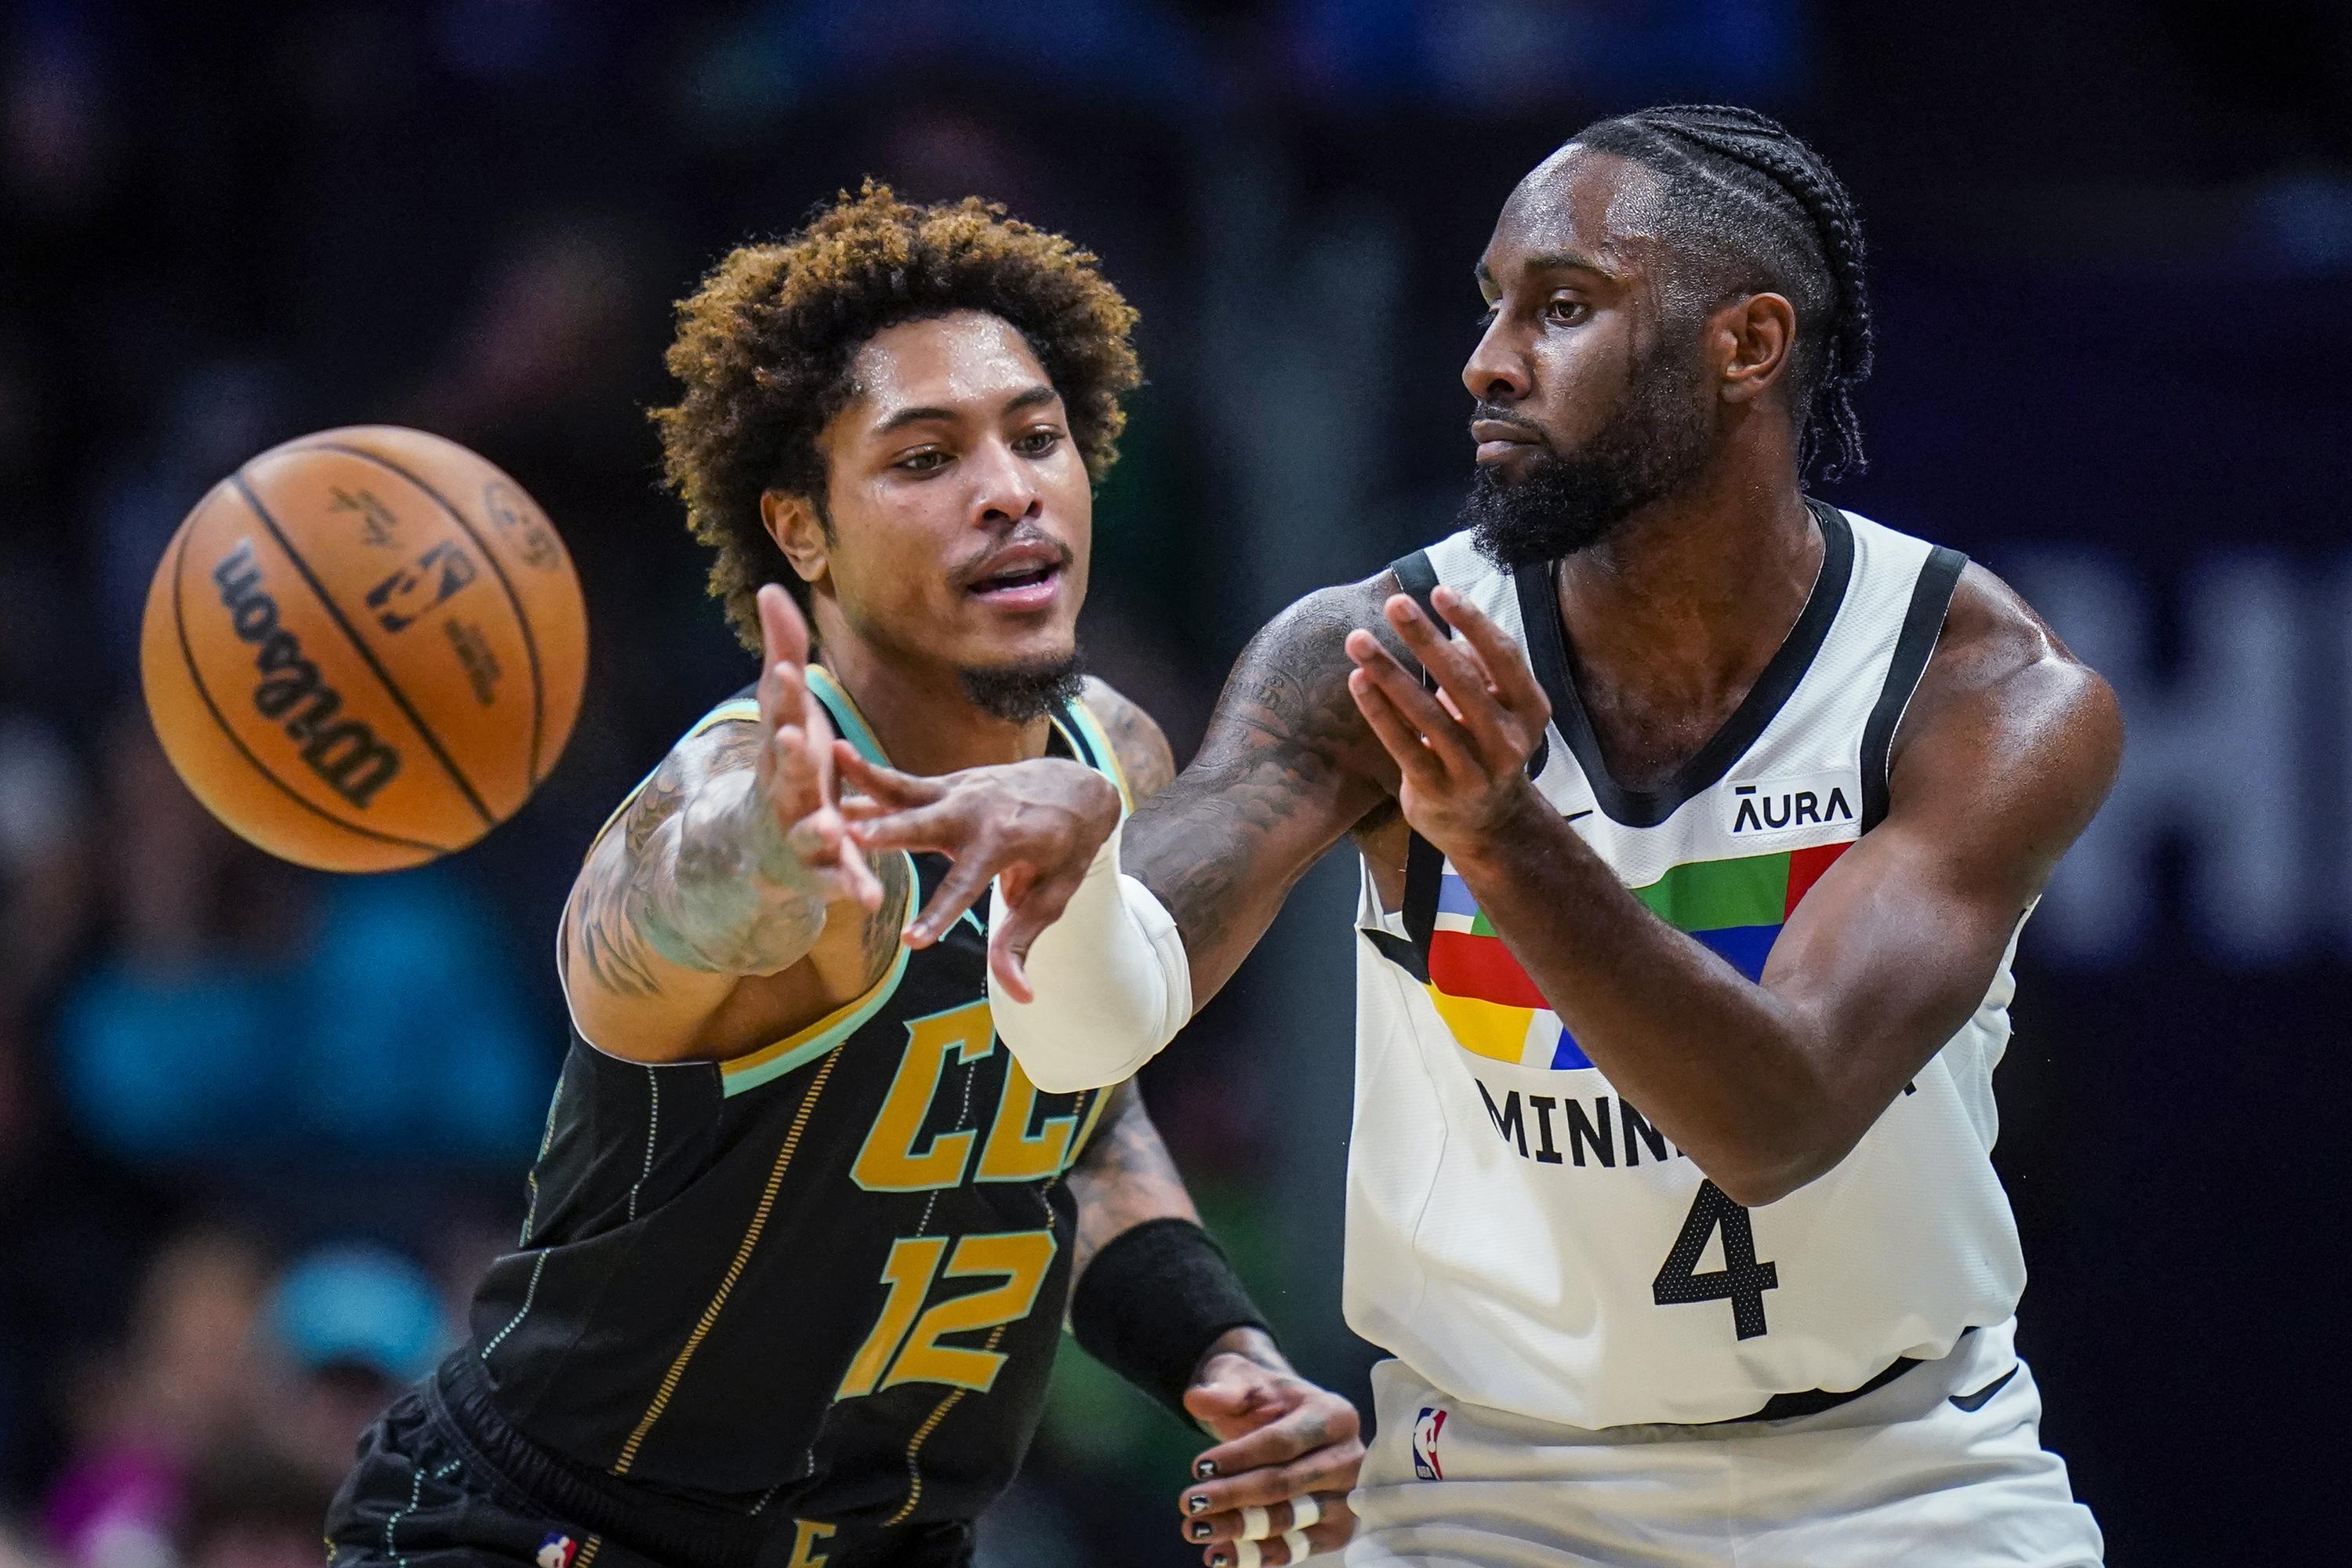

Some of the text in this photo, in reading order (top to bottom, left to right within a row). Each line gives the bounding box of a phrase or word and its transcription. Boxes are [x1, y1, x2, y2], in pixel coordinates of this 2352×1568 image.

[213, 539, 401, 810] Wilson
[849, 998, 1113, 1192] CL
[1475, 1079, 1688, 1168] MINN
[834, 1229, 1058, 1402] 12
[1652, 1178, 1778, 1341] 4
